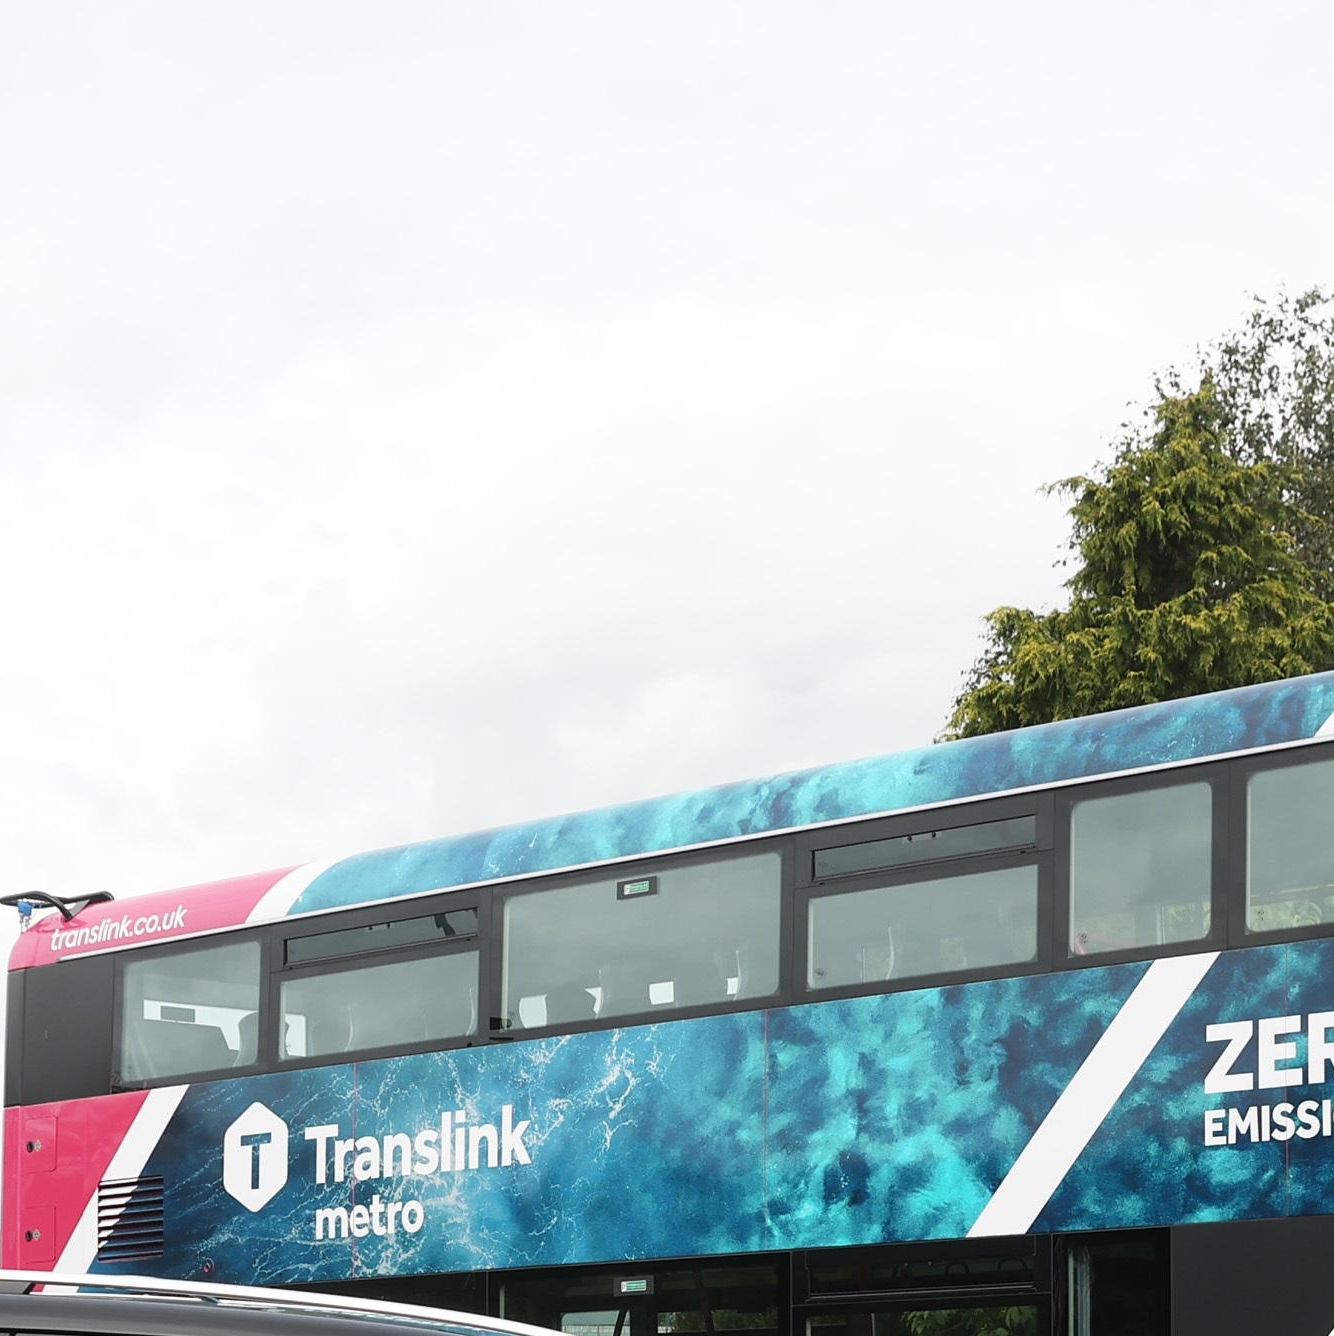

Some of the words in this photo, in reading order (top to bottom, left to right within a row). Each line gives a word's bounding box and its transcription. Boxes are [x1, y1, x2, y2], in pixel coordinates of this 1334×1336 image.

[51, 904, 187, 951] translink.co.uk
[304, 1104, 532, 1185] Translink
[316, 1194, 425, 1240] metro
